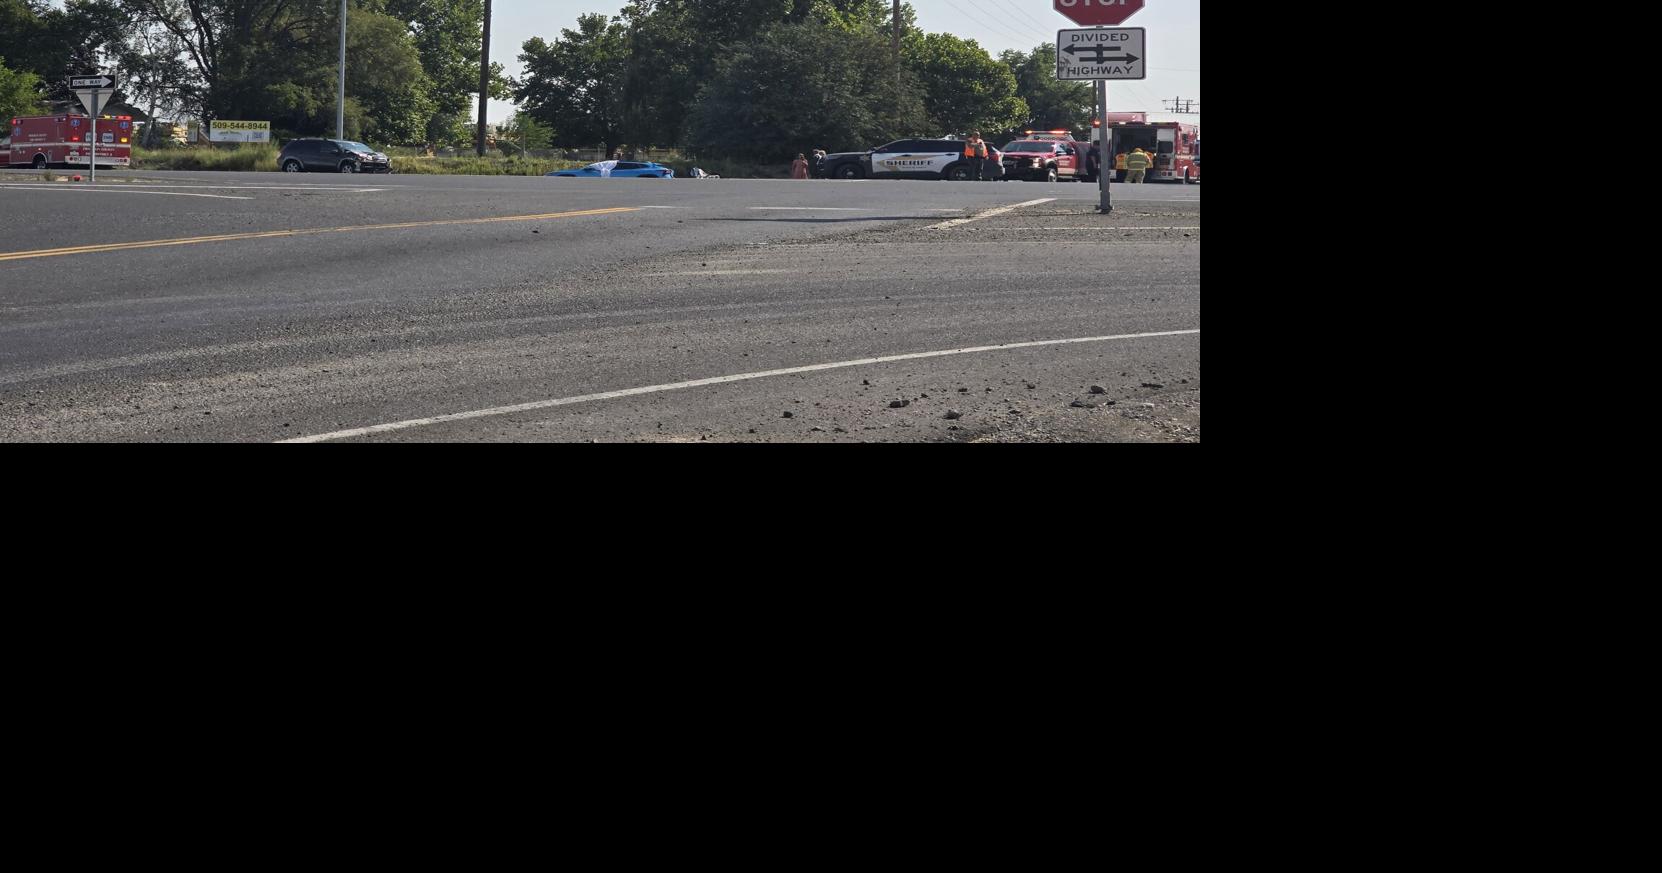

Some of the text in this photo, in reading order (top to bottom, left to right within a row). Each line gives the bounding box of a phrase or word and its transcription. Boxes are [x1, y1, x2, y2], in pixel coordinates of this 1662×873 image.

[1071, 33, 1129, 42] DIVIDED
[1067, 65, 1133, 75] HIGHWAY
[212, 121, 268, 130] 509-544-8944
